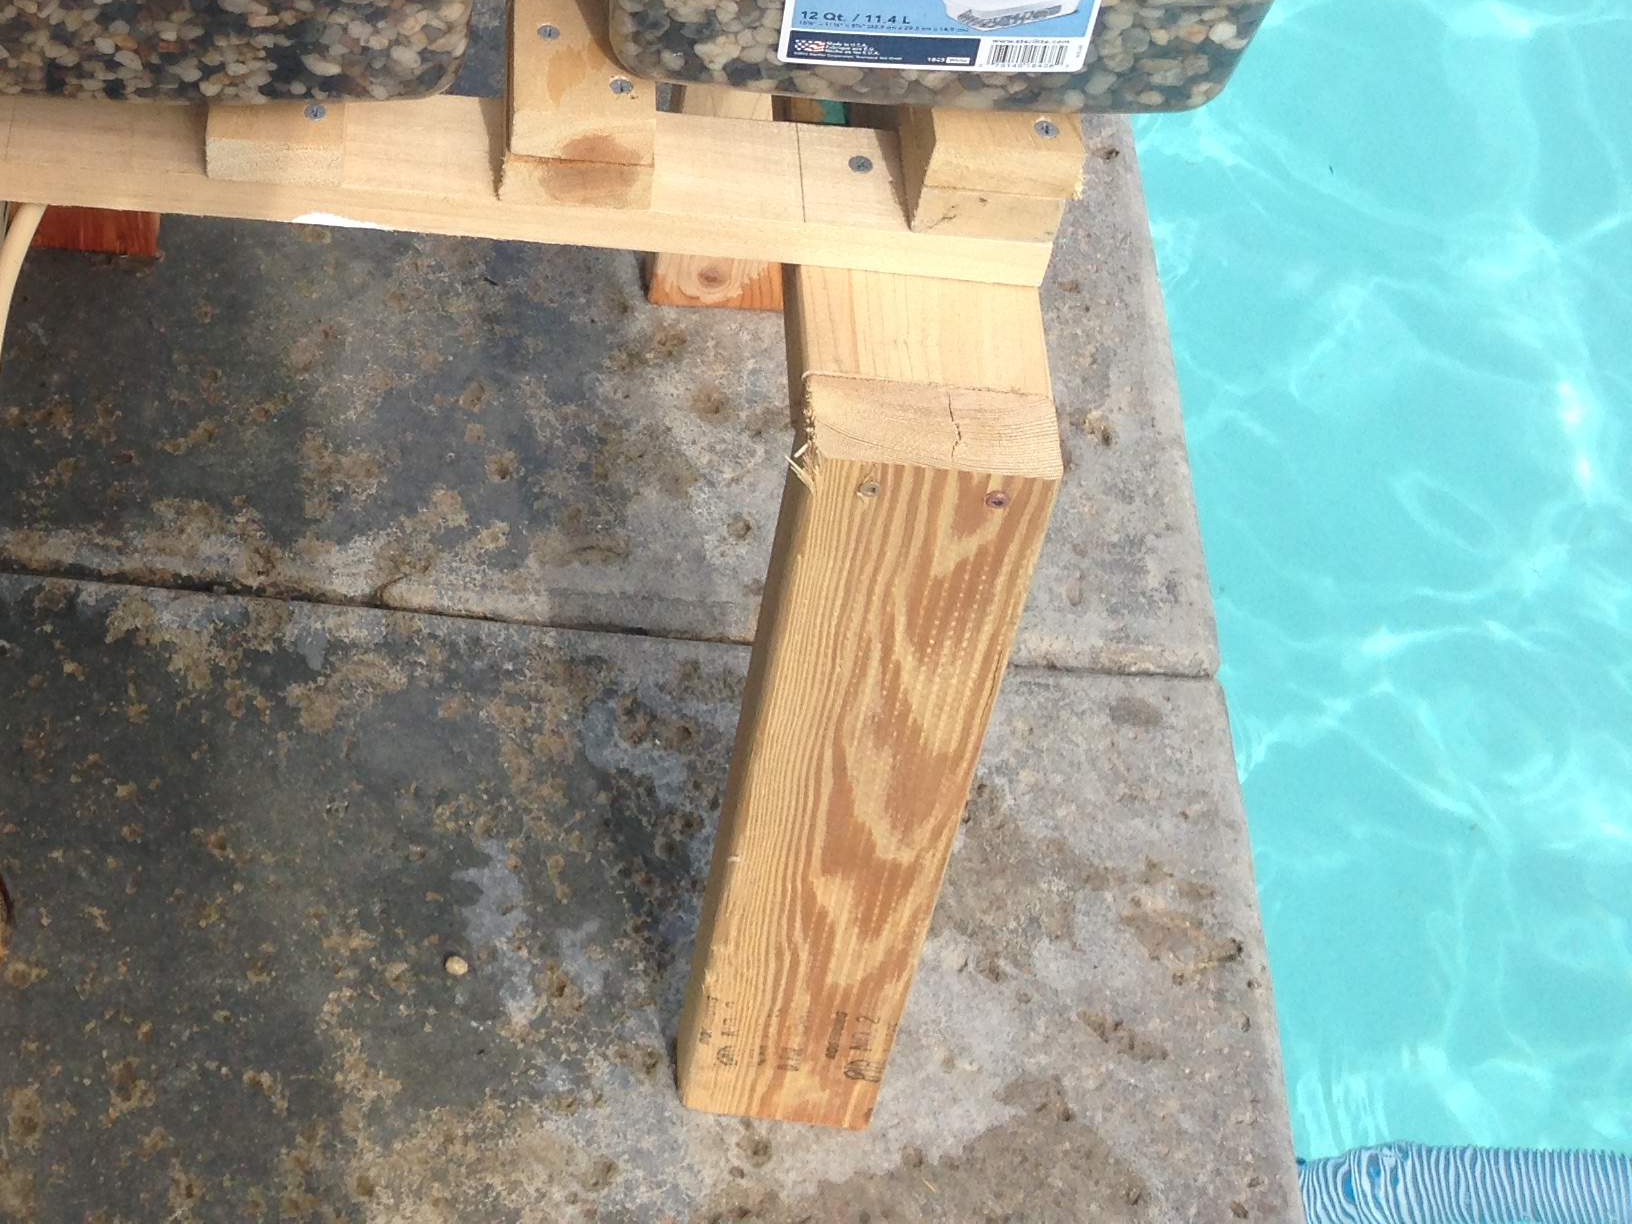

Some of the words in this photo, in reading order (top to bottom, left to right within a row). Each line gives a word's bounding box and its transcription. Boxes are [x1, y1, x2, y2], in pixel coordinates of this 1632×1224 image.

[801, 10, 819, 21] 12
[823, 12, 846, 23] Qt.
[851, 13, 861, 23] /
[865, 14, 896, 25] 11.4
[902, 16, 911, 25] L
